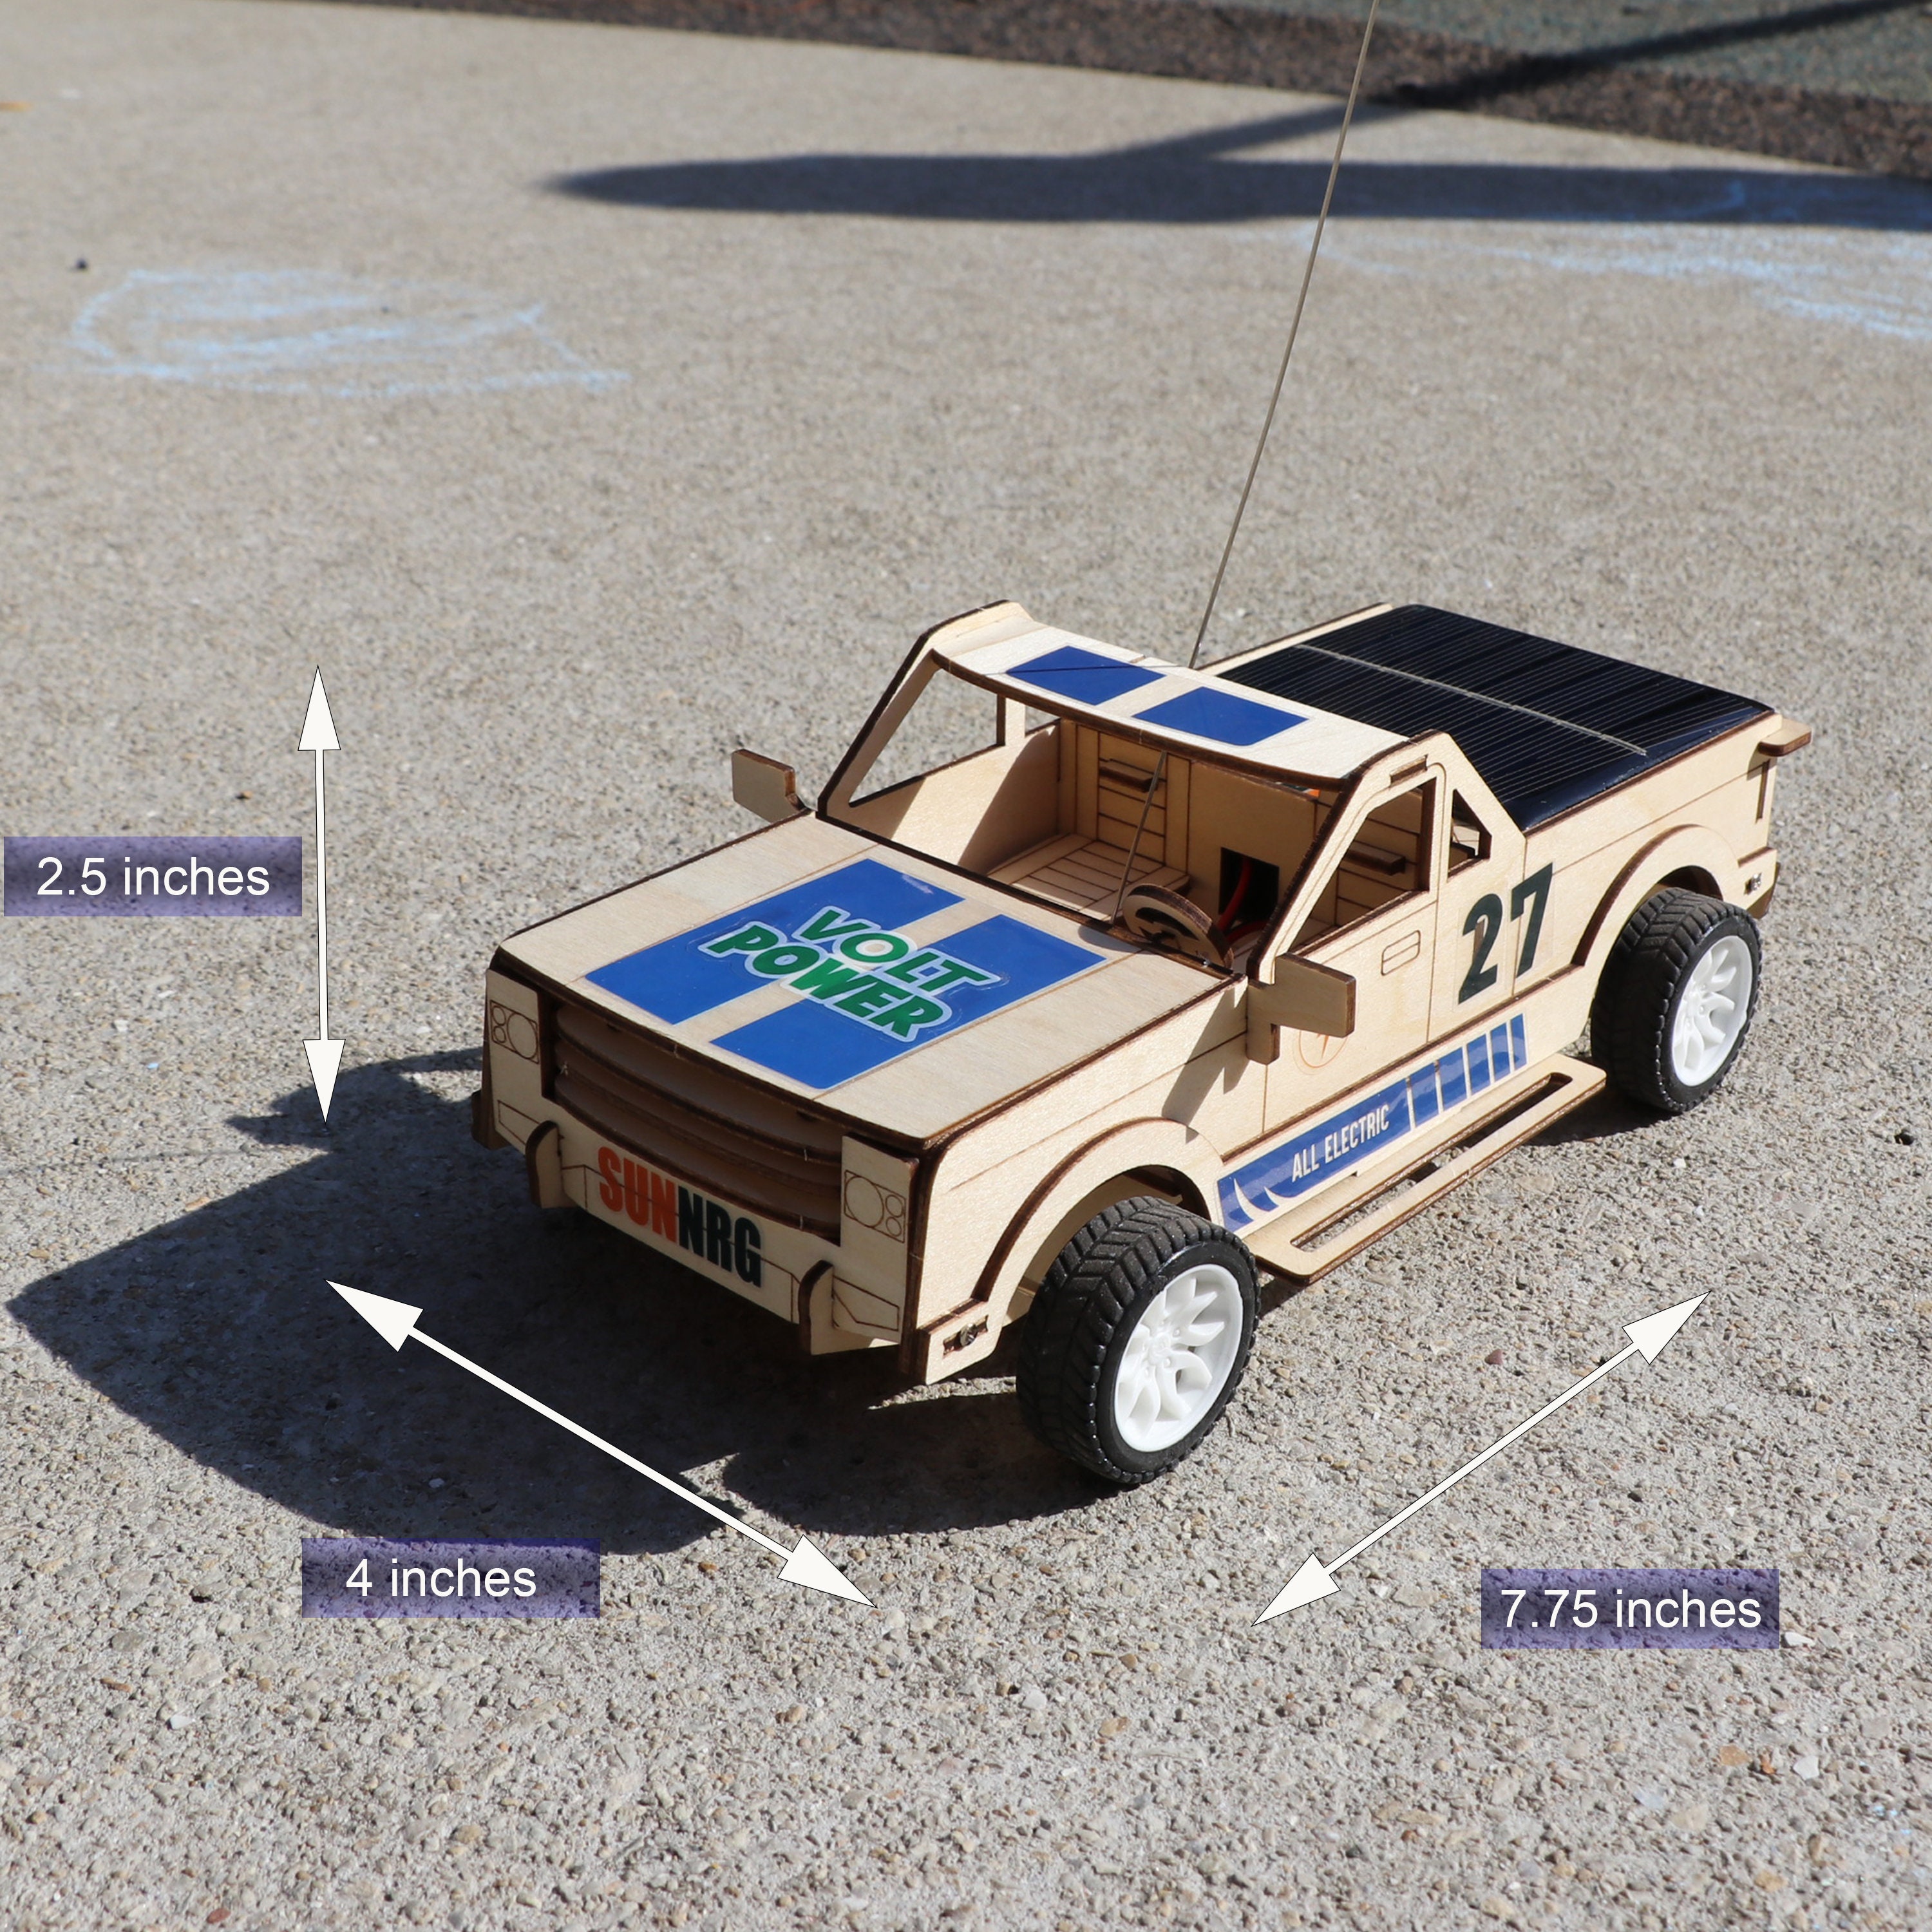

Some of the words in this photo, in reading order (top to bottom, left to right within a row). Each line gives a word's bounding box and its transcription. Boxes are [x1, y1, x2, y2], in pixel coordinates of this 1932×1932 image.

[705, 923, 946, 1039] POWER
[797, 909, 995, 993] VOLT
[1458, 862, 1553, 1005] 27
[1292, 1144, 1320, 1182] ALL
[1324, 1104, 1390, 1164] ELECTRIC
[598, 1146, 762, 1288] SUNNRG
